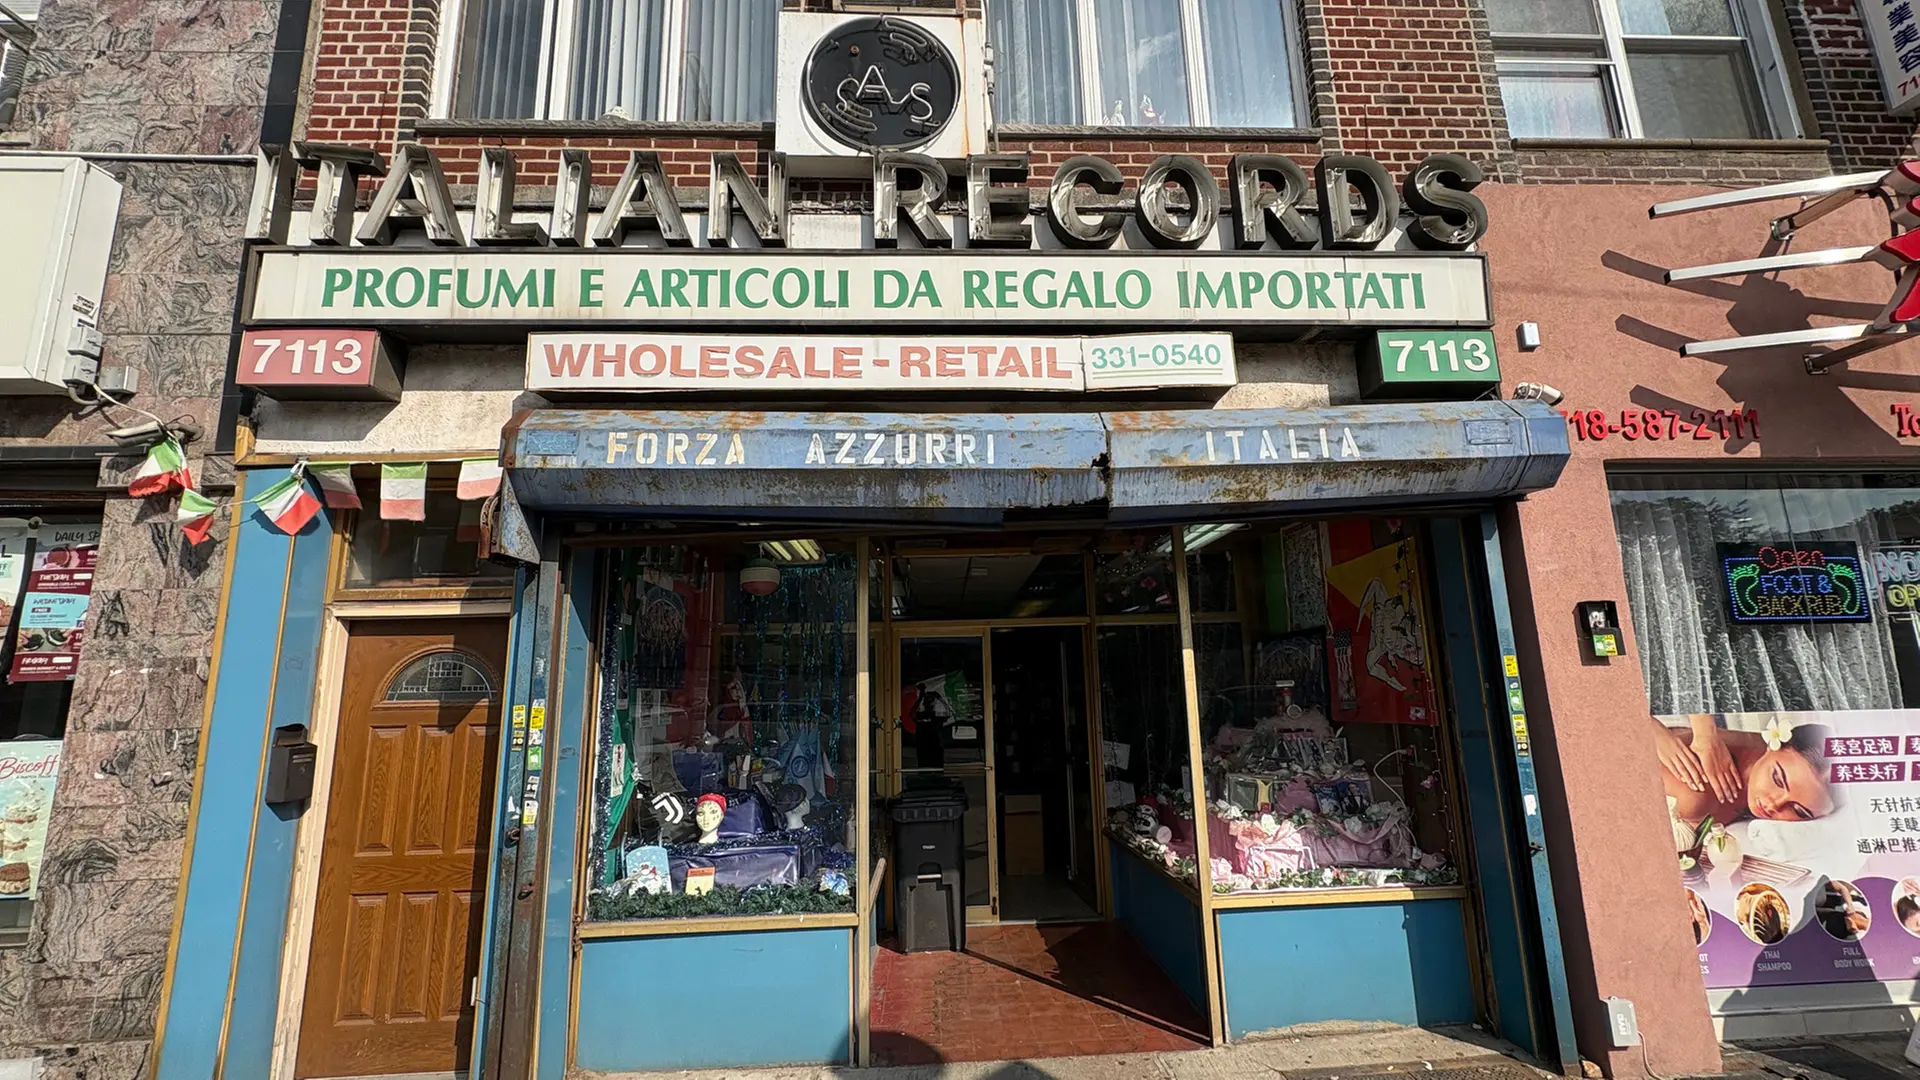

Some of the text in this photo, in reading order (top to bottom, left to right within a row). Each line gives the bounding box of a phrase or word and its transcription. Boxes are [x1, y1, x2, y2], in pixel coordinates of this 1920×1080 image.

[244, 141, 1489, 251] ITALIAN RECORDS
[322, 268, 1425, 309] PROFUMI E ARTICOLI DA REGALO IMPORTATI
[252, 338, 362, 375] 7113
[1092, 344, 1222, 369] 331-0540
[1388, 338, 1491, 373] 7113
[1559, 409, 1762, 441] 18-587-2111
[607, 430, 996, 468] FORZA AZZURRI
[1205, 426, 1362, 462] ITALIA
[55, 531, 84, 542] DAILY
[1759, 546, 1826, 569] Open
[1760, 574, 1833, 595] FOOT &
[1856, 837, 1920, 854] 通淋巴推
[1763, 950, 1780, 960] THAI
[1834, 958, 1853, 969] BODY
[1843, 947, 1860, 956] FULL
[1757, 962, 1792, 972] SHAMPOO
